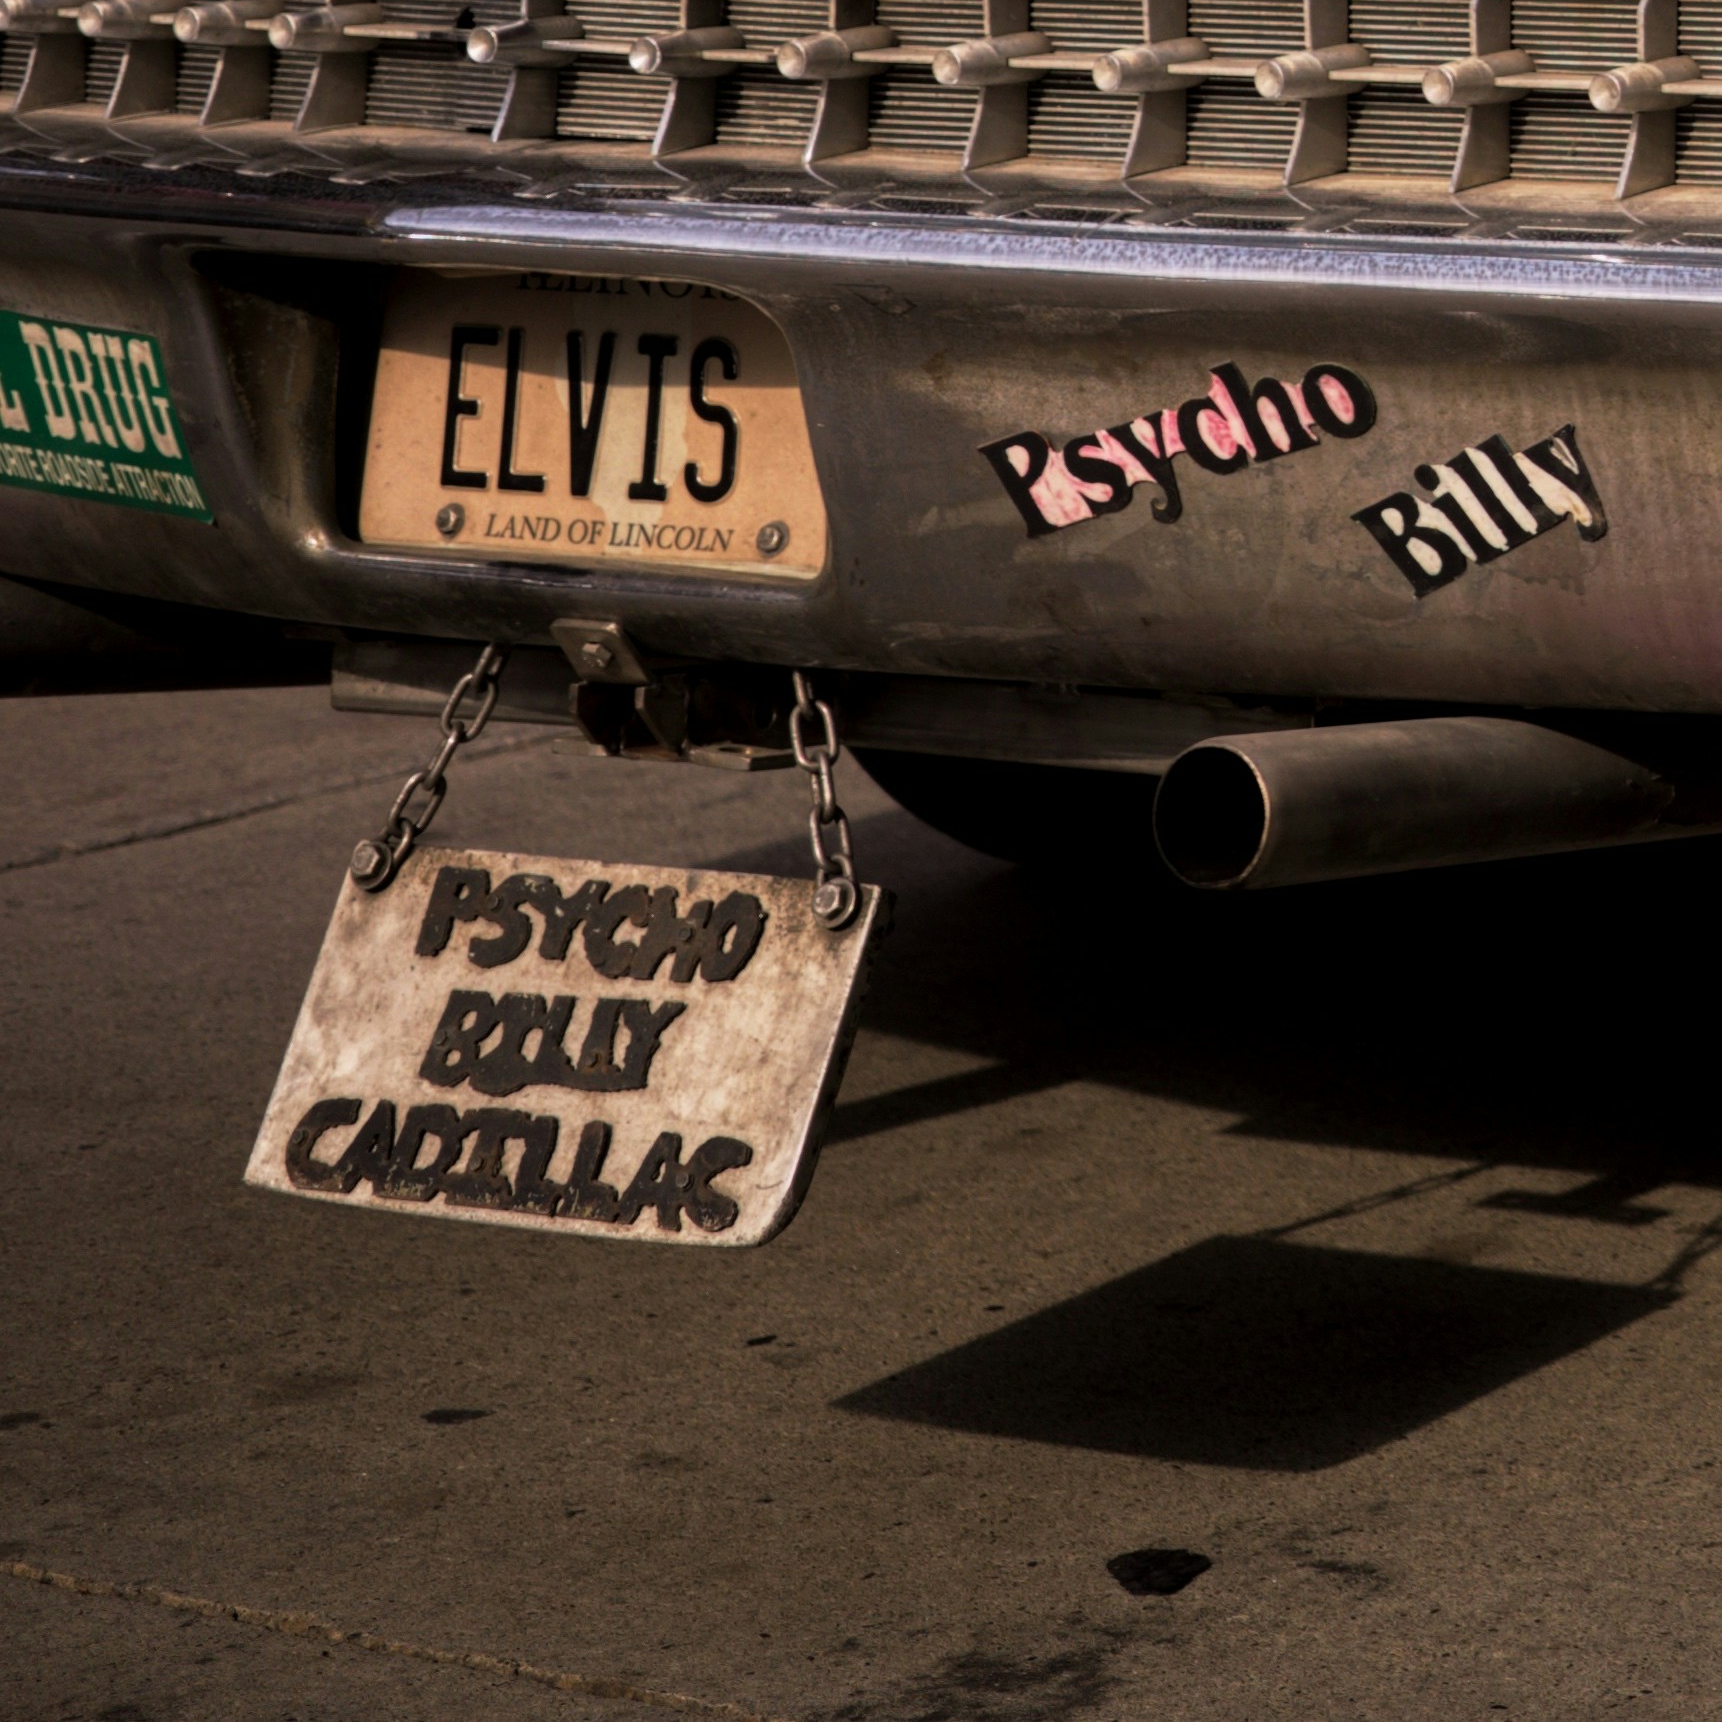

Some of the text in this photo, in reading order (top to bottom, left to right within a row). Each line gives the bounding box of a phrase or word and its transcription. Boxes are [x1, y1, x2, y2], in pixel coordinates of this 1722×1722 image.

[18, 320, 183, 460] DRUG
[440, 324, 739, 503] ELVIS
[978, 360, 1377, 538] Psycho
[35, 448, 116, 494] ROADSIDE
[109, 462, 206, 510] ATTRACTION
[484, 513, 734, 552] LAND OF LINCOLN
[1351, 423, 1607, 600] Billy
[415, 865, 768, 982] PSYCHO
[420, 990, 687, 1097] BILLY
[285, 1098, 752, 1232] CADILLAC
